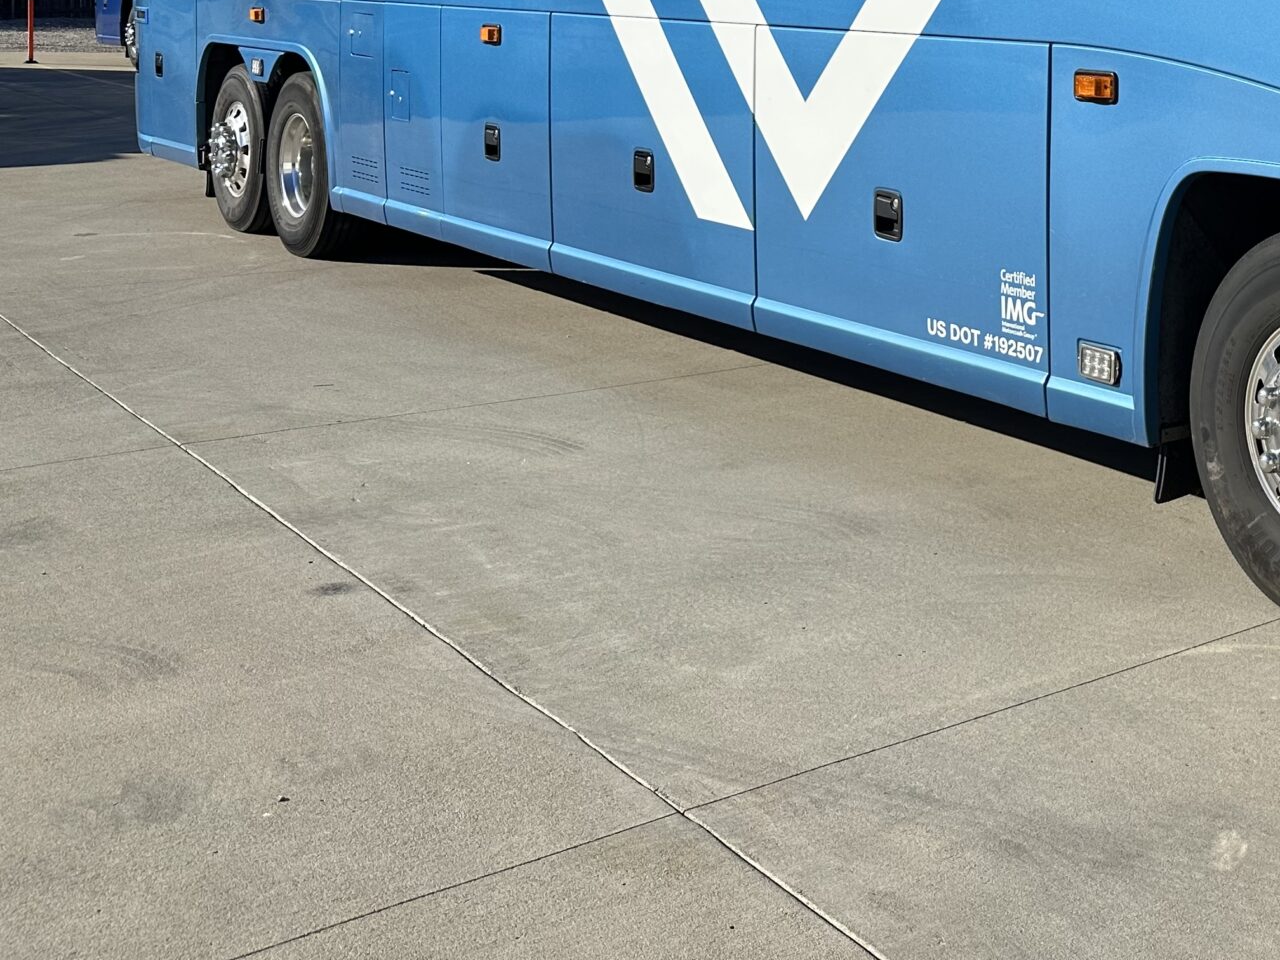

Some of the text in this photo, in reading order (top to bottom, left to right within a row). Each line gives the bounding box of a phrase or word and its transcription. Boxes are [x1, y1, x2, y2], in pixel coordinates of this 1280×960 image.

[1000, 269, 1036, 287] Certified
[1000, 282, 1036, 300] Member
[1001, 295, 1045, 325] IMG
[927, 317, 947, 338] US
[950, 323, 981, 346] DOT
[983, 333, 1044, 363] #192507
